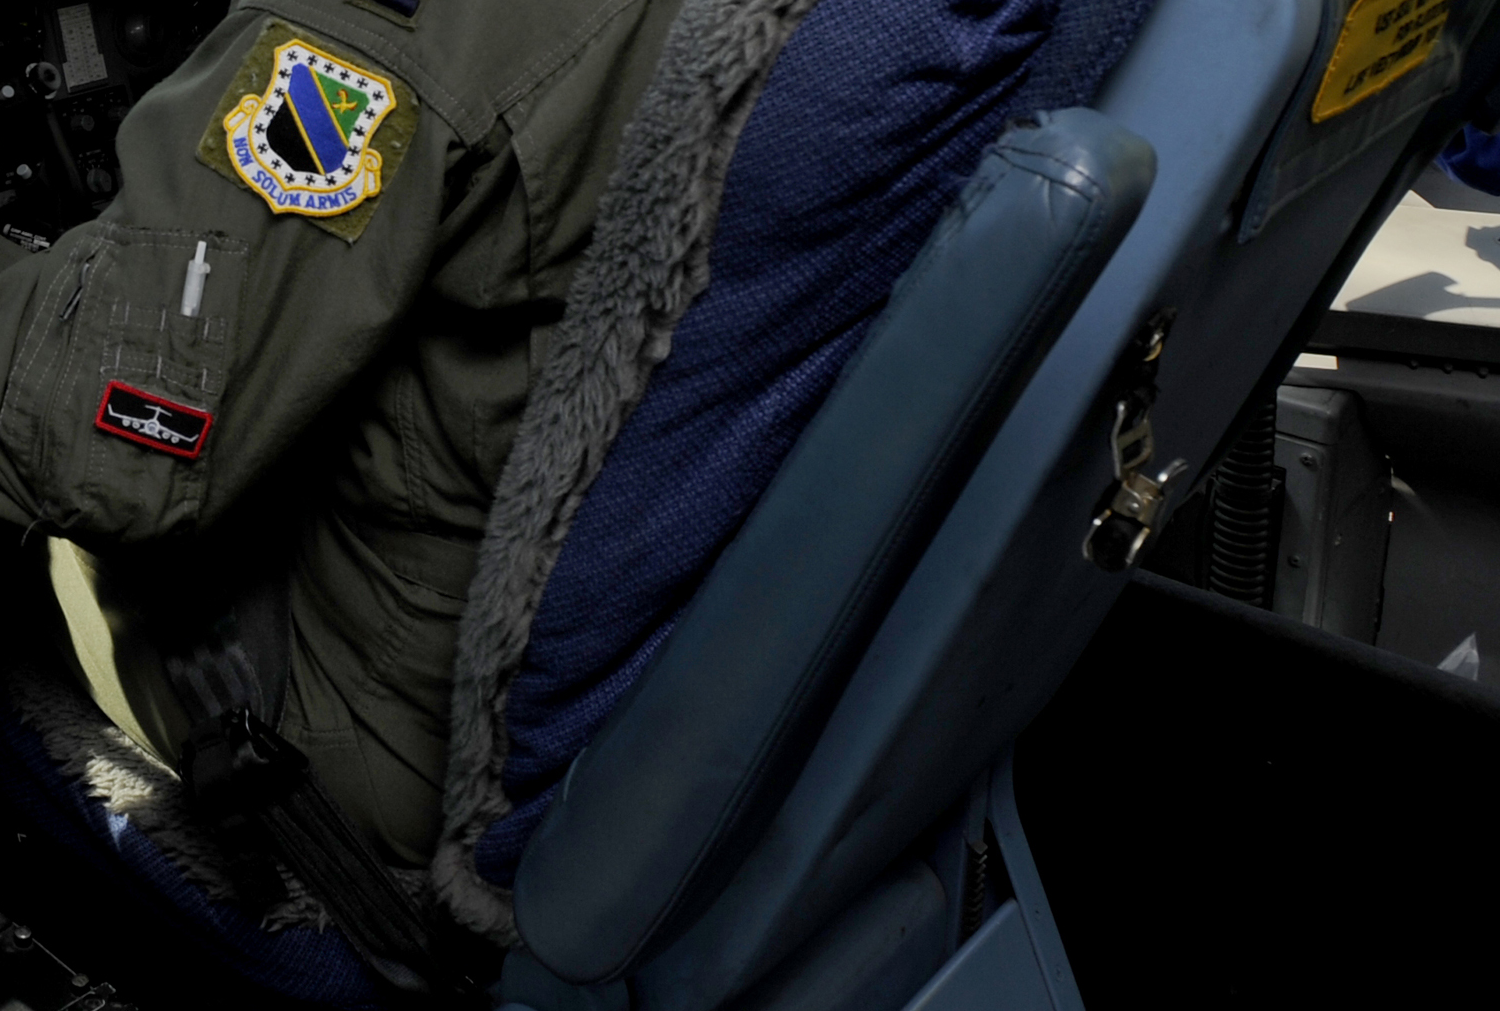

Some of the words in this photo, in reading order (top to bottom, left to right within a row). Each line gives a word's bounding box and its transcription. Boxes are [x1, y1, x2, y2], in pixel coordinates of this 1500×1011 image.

[233, 136, 255, 168] NON
[251, 169, 302, 207] SOLUM
[304, 185, 358, 210] ARMIS
